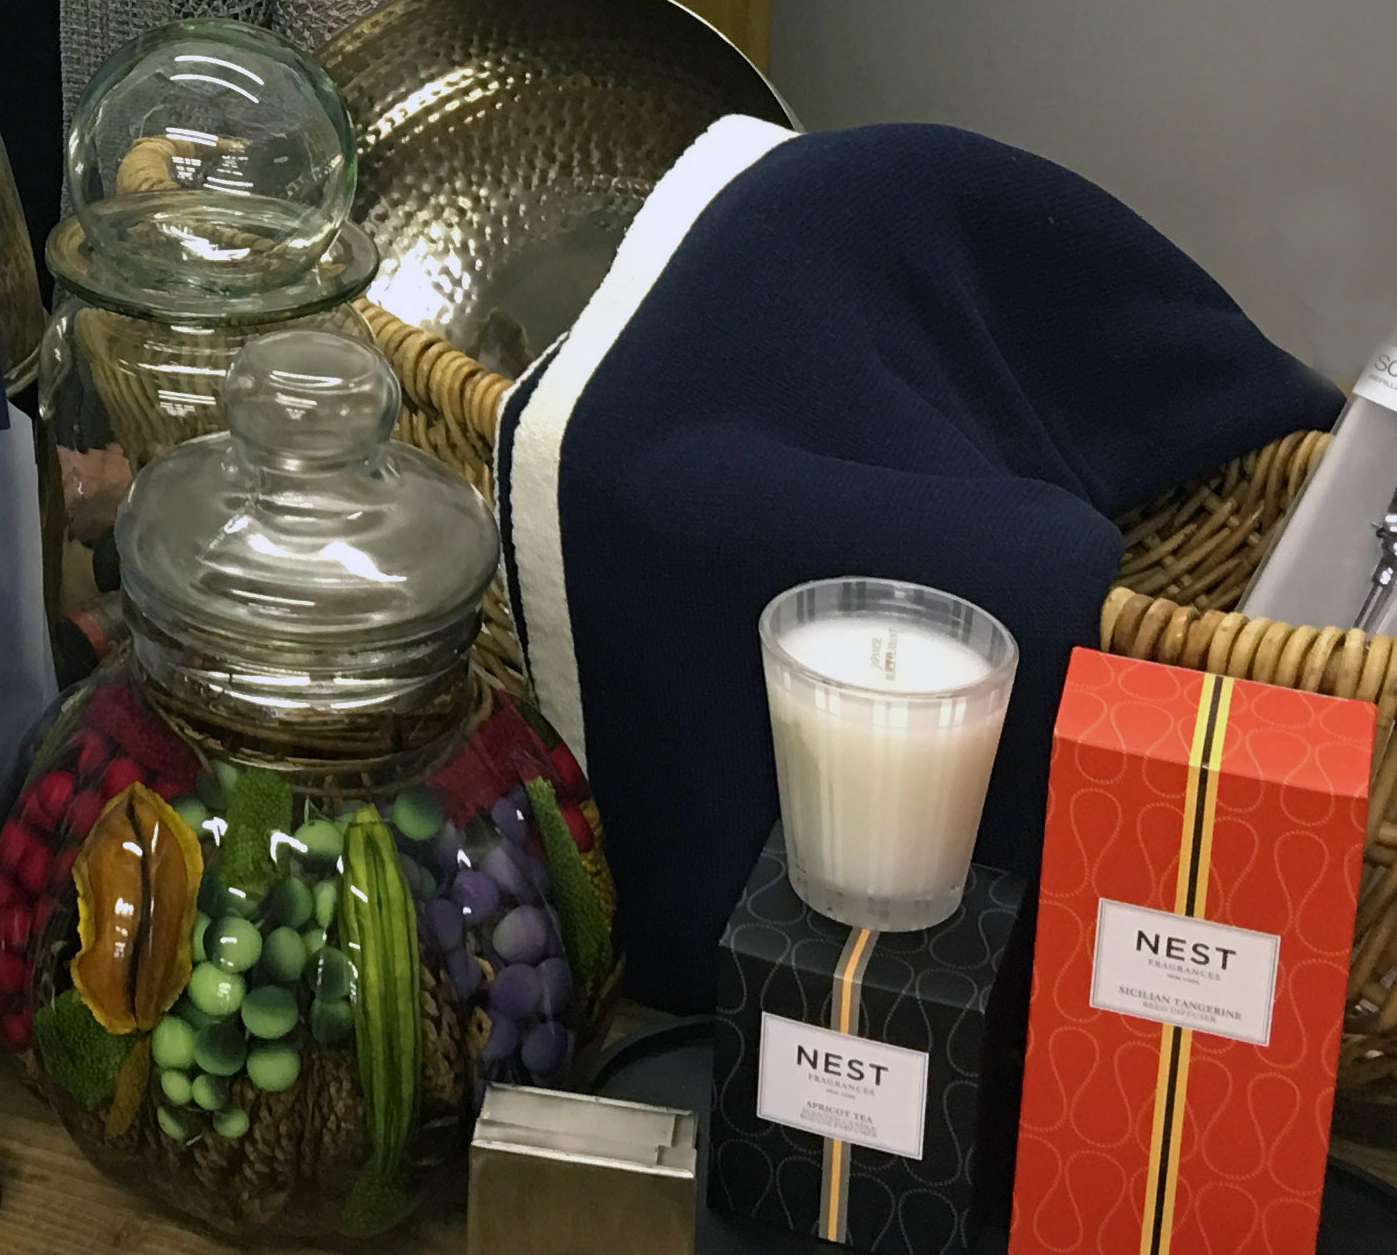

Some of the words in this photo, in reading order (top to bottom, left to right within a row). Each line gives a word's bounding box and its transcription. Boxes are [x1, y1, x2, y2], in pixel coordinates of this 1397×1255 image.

[1135, 929, 1237, 971] NEST
[1147, 958, 1221, 981] FRAGRANCES
[1118, 985, 1171, 1005] SICILIAN
[1174, 997, 1242, 1021] TANGERINE
[796, 1044, 889, 1087] NEST
[807, 1100, 849, 1118] APRICOT
[854, 1112, 873, 1124] TEA
